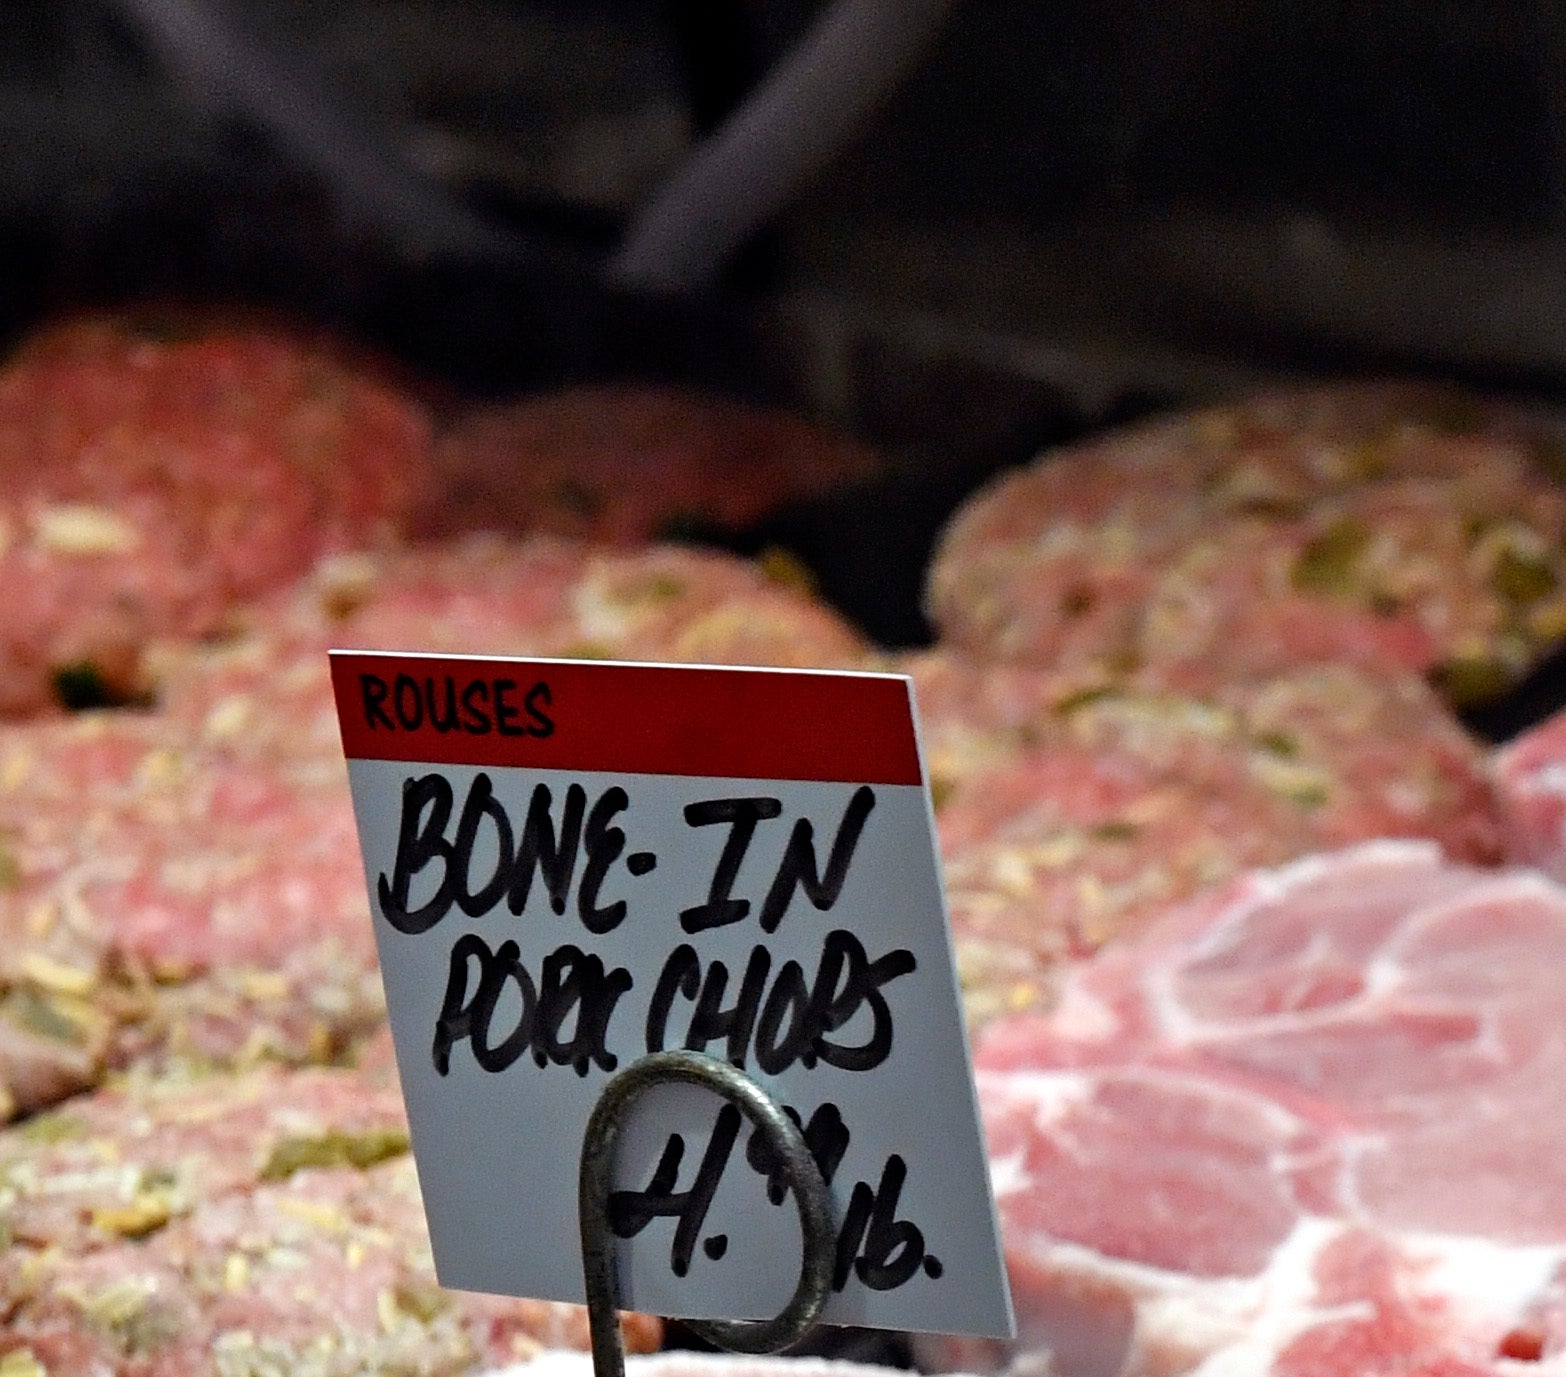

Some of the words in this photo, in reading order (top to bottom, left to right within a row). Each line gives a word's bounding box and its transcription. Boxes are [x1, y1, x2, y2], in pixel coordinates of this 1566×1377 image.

[359, 673, 555, 739] ROUSES
[377, 771, 657, 935] BONE-
[679, 784, 876, 934] IN
[431, 932, 634, 1078] PORK
[645, 929, 918, 1077] CHOPS
